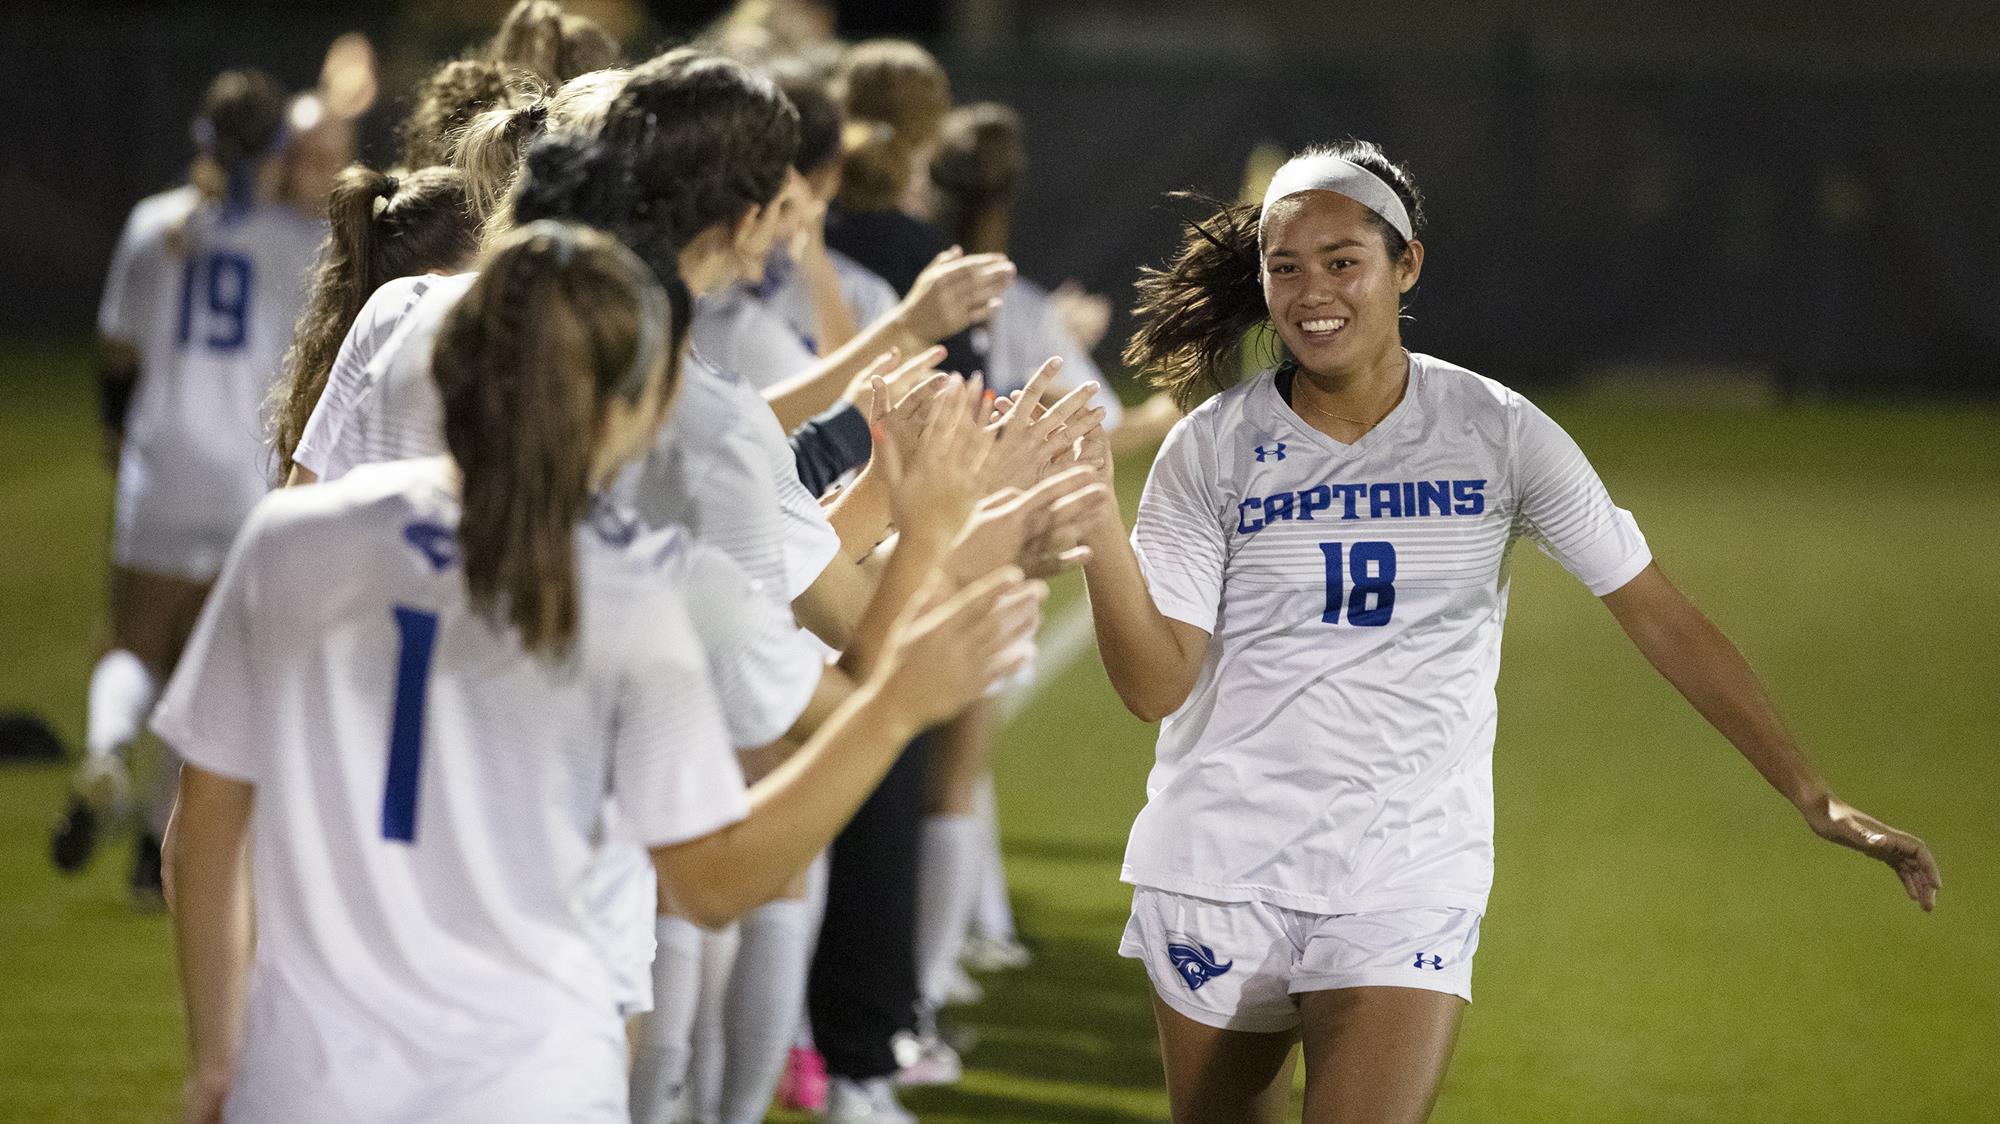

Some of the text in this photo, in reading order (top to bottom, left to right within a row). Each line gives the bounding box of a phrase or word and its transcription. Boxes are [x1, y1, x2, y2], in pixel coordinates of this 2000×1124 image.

[178, 252, 253, 351] 19
[1237, 479, 1488, 534] CAPTAINS
[1319, 541, 1396, 627] 18
[380, 605, 439, 842] 1
